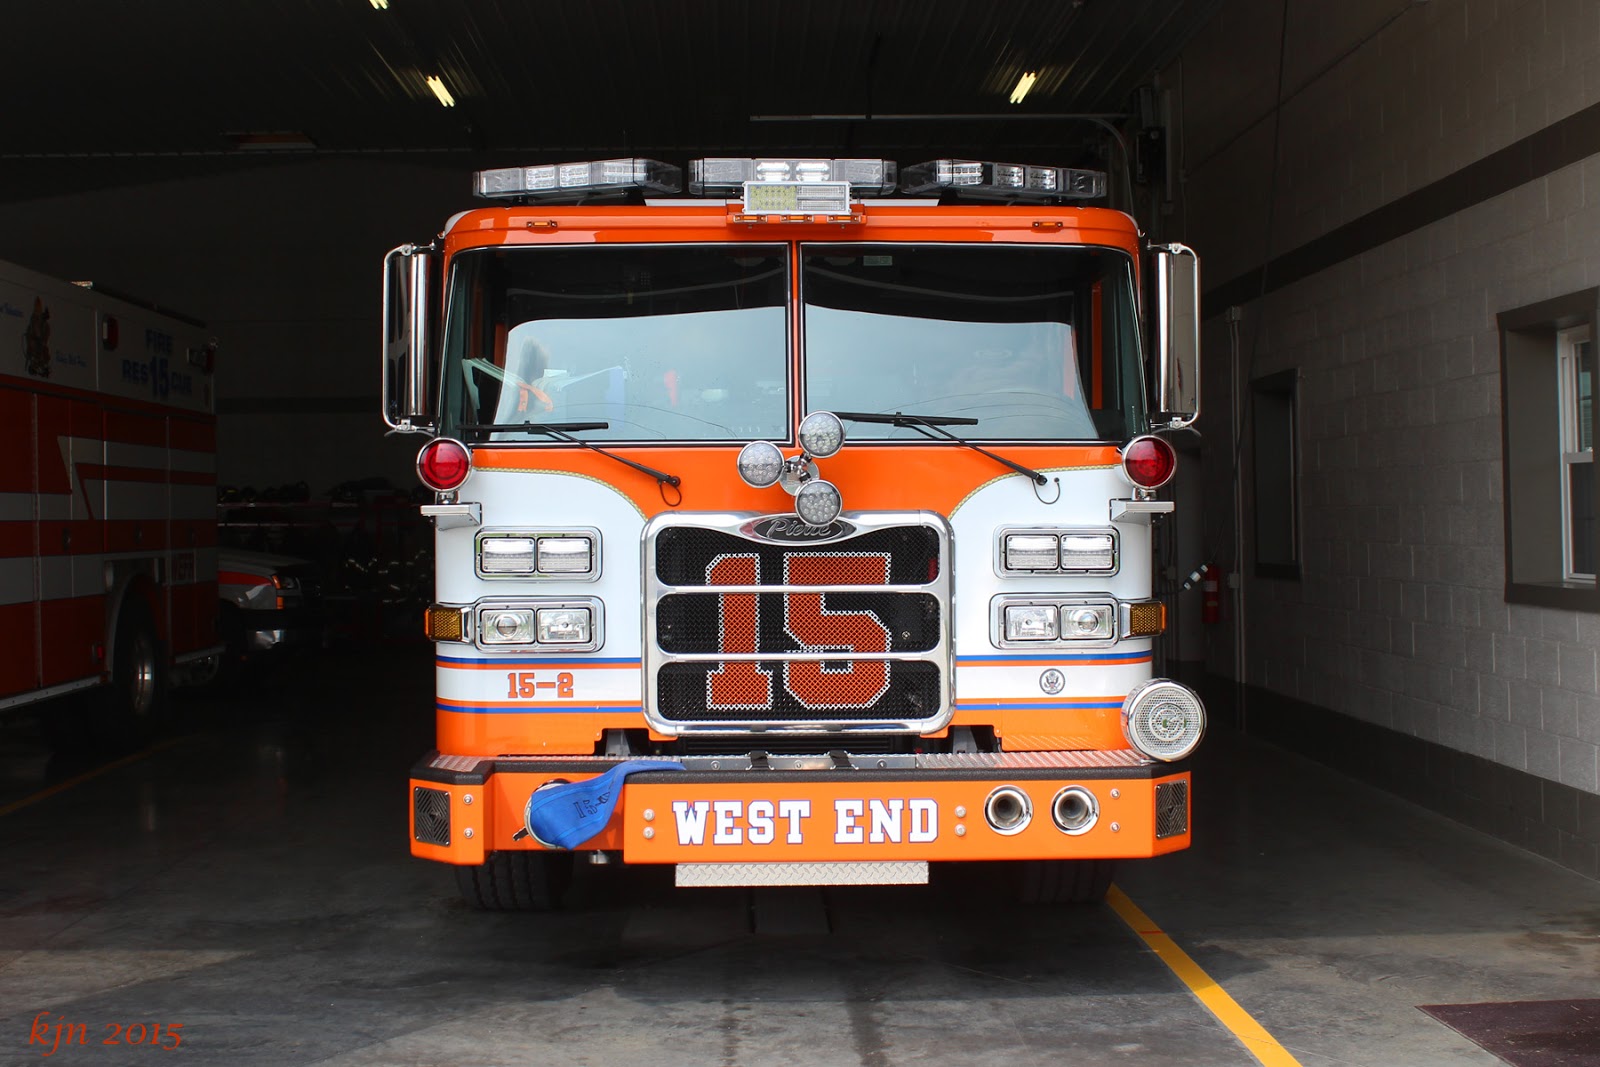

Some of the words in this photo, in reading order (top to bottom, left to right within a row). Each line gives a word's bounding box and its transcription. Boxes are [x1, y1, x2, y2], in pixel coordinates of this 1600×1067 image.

[145, 328, 173, 356] FIRE
[122, 359, 149, 385] RES
[150, 356, 169, 397] 15
[705, 552, 891, 709] 15
[507, 672, 574, 699] 15-2
[672, 800, 811, 845] WEST
[834, 798, 938, 844] END
